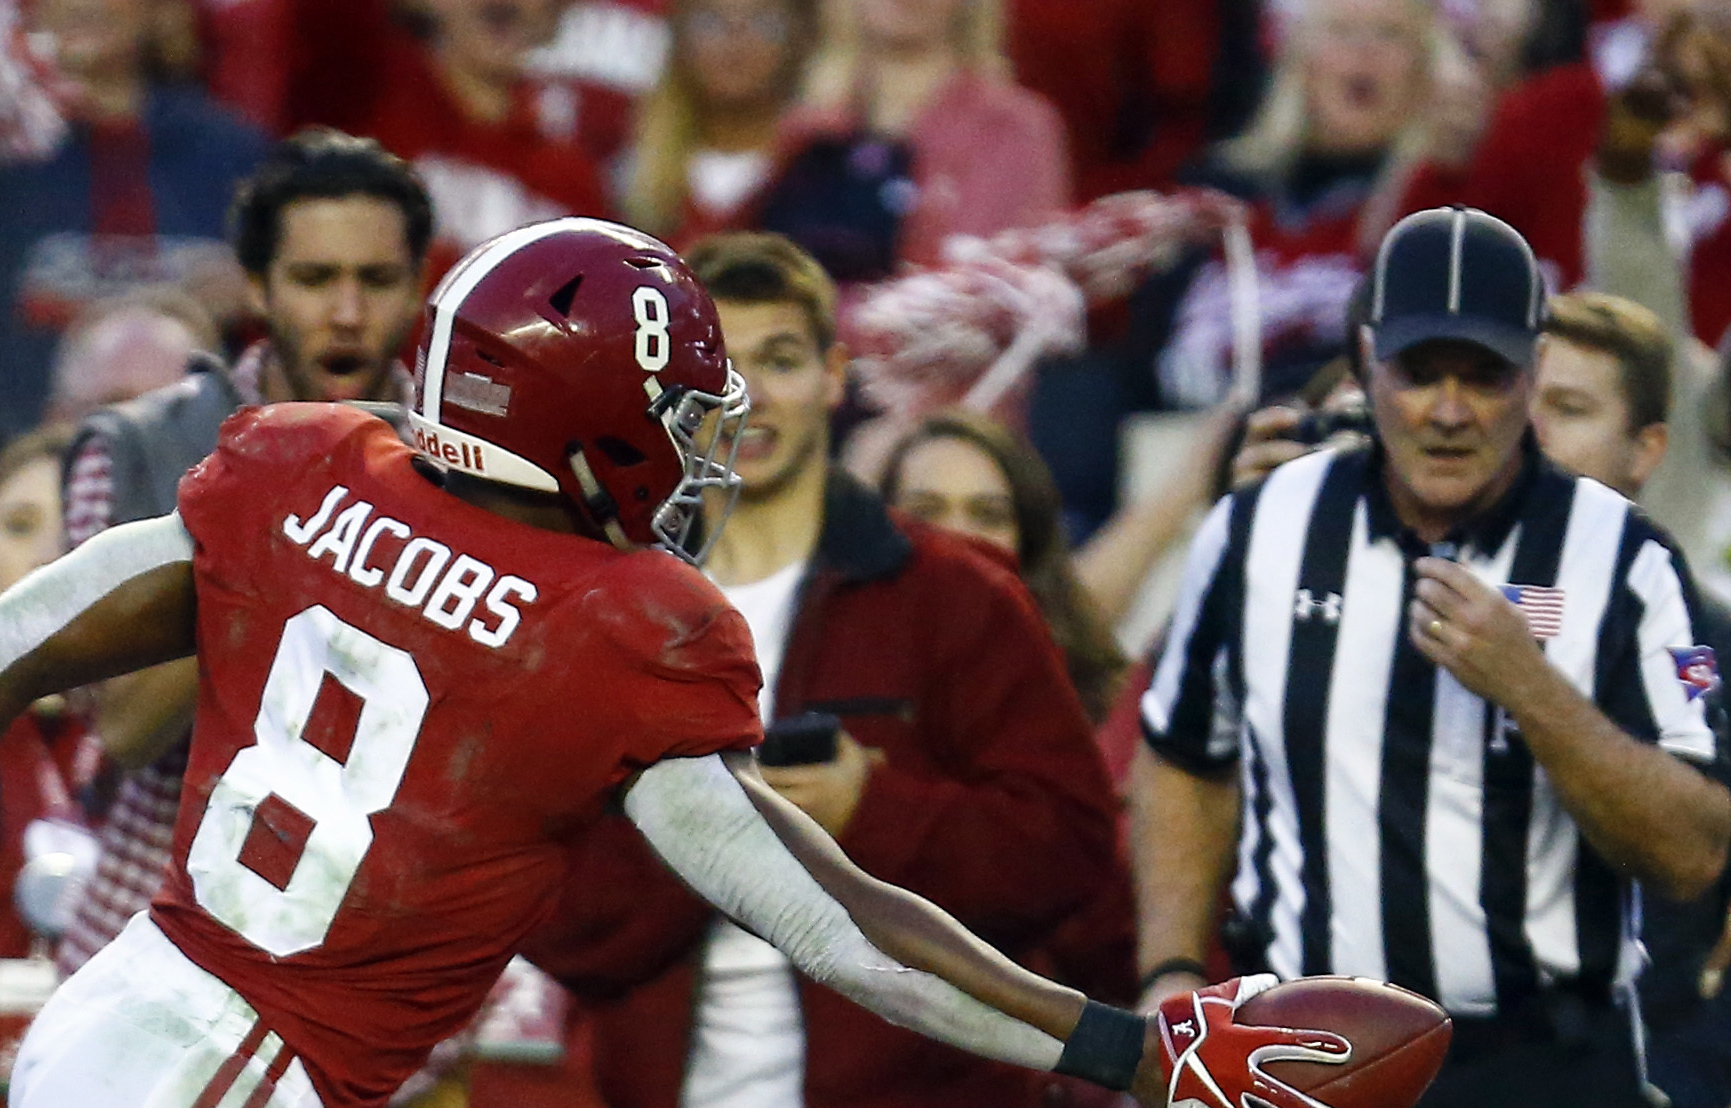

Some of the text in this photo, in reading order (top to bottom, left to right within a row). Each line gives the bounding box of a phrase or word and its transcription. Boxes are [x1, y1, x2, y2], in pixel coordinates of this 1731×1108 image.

[631, 285, 671, 371] 8
[412, 427, 484, 471] ddell
[283, 486, 537, 648] JACOBS
[188, 604, 430, 957] 8
